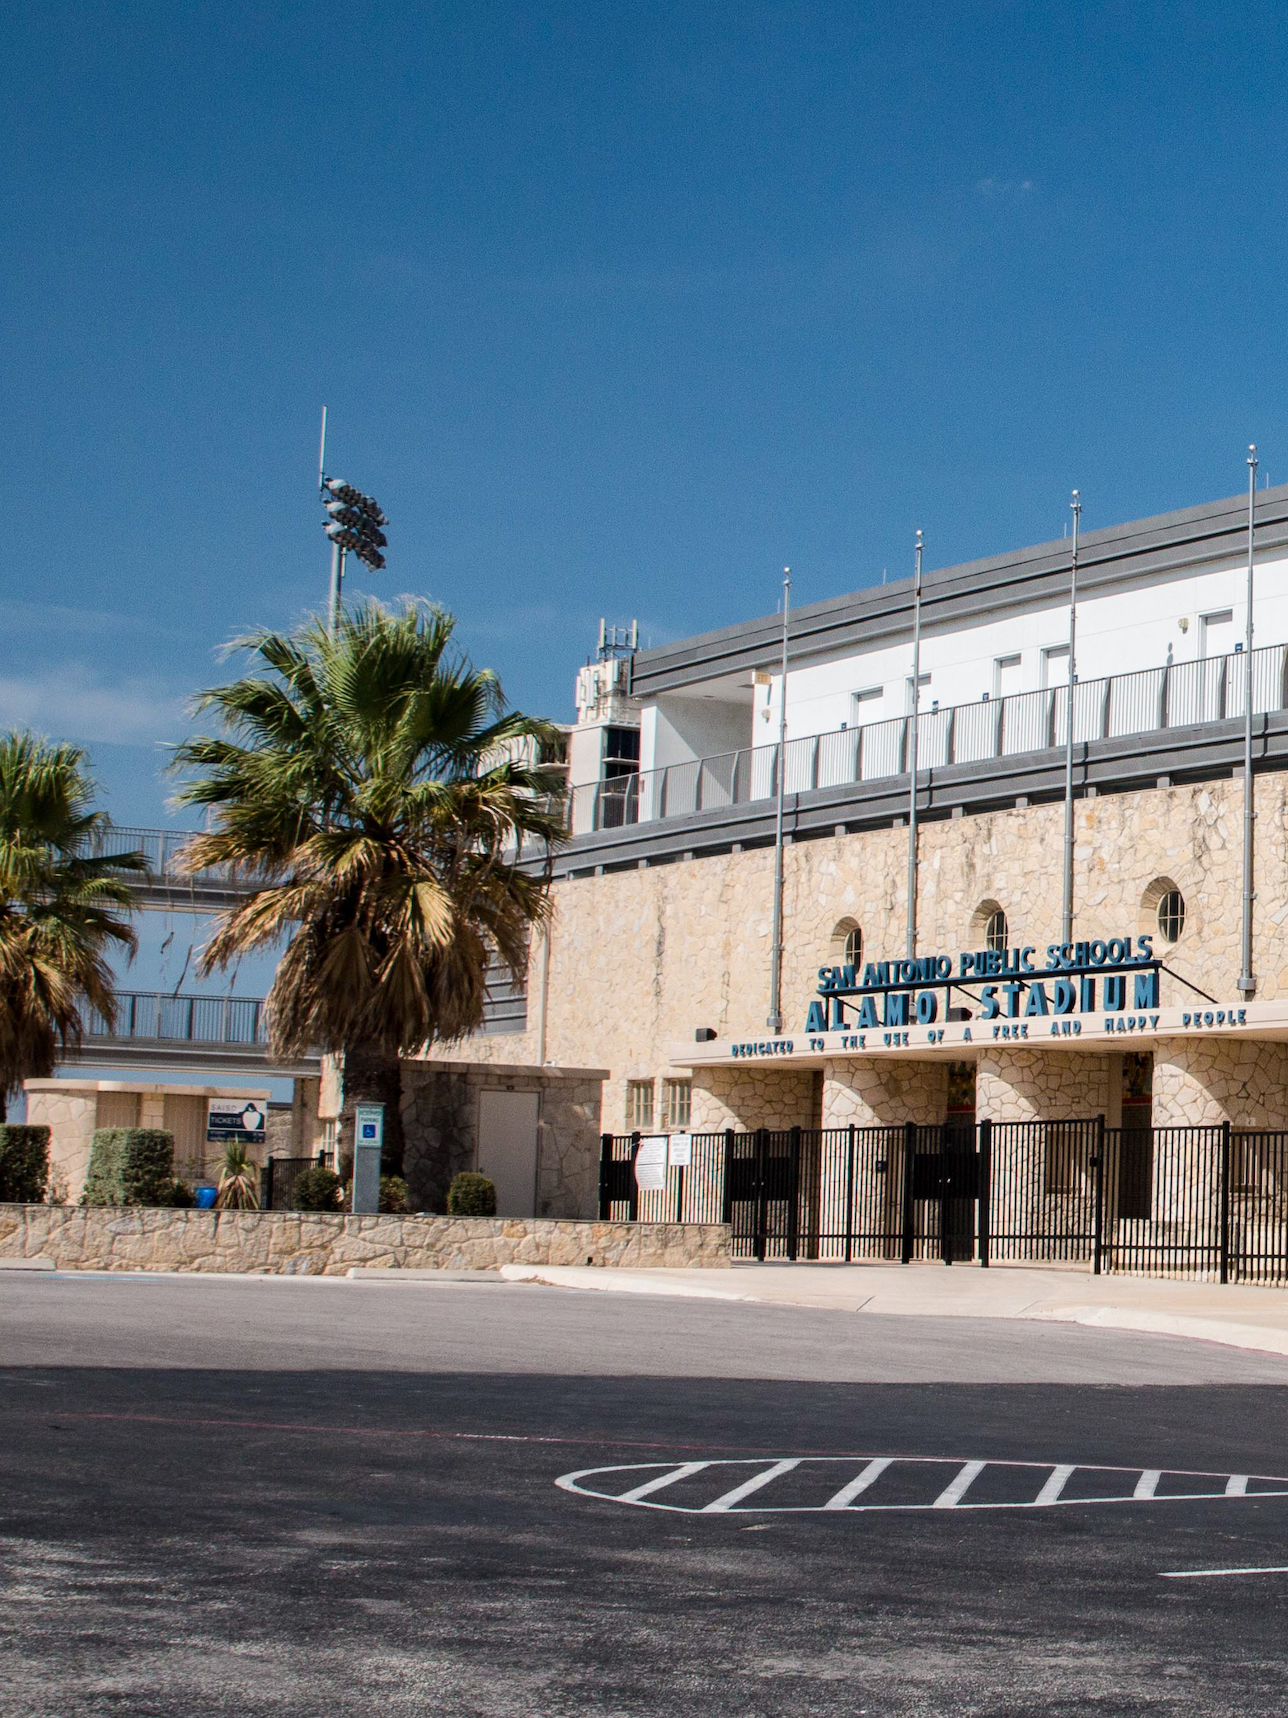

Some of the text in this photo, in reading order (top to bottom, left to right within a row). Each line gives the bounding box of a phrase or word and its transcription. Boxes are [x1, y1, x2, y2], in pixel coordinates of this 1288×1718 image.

[818, 935, 1153, 990] SAN ANTONIO PUBLIC SCHOOLS
[805, 973, 1160, 1033] ALAMO STADIUM
[731, 1009, 1247, 1057] DEDICATED TO THE USE OF A FREE AND HAPPY PEOPLE
[210, 1116, 242, 1125] TICKETS
